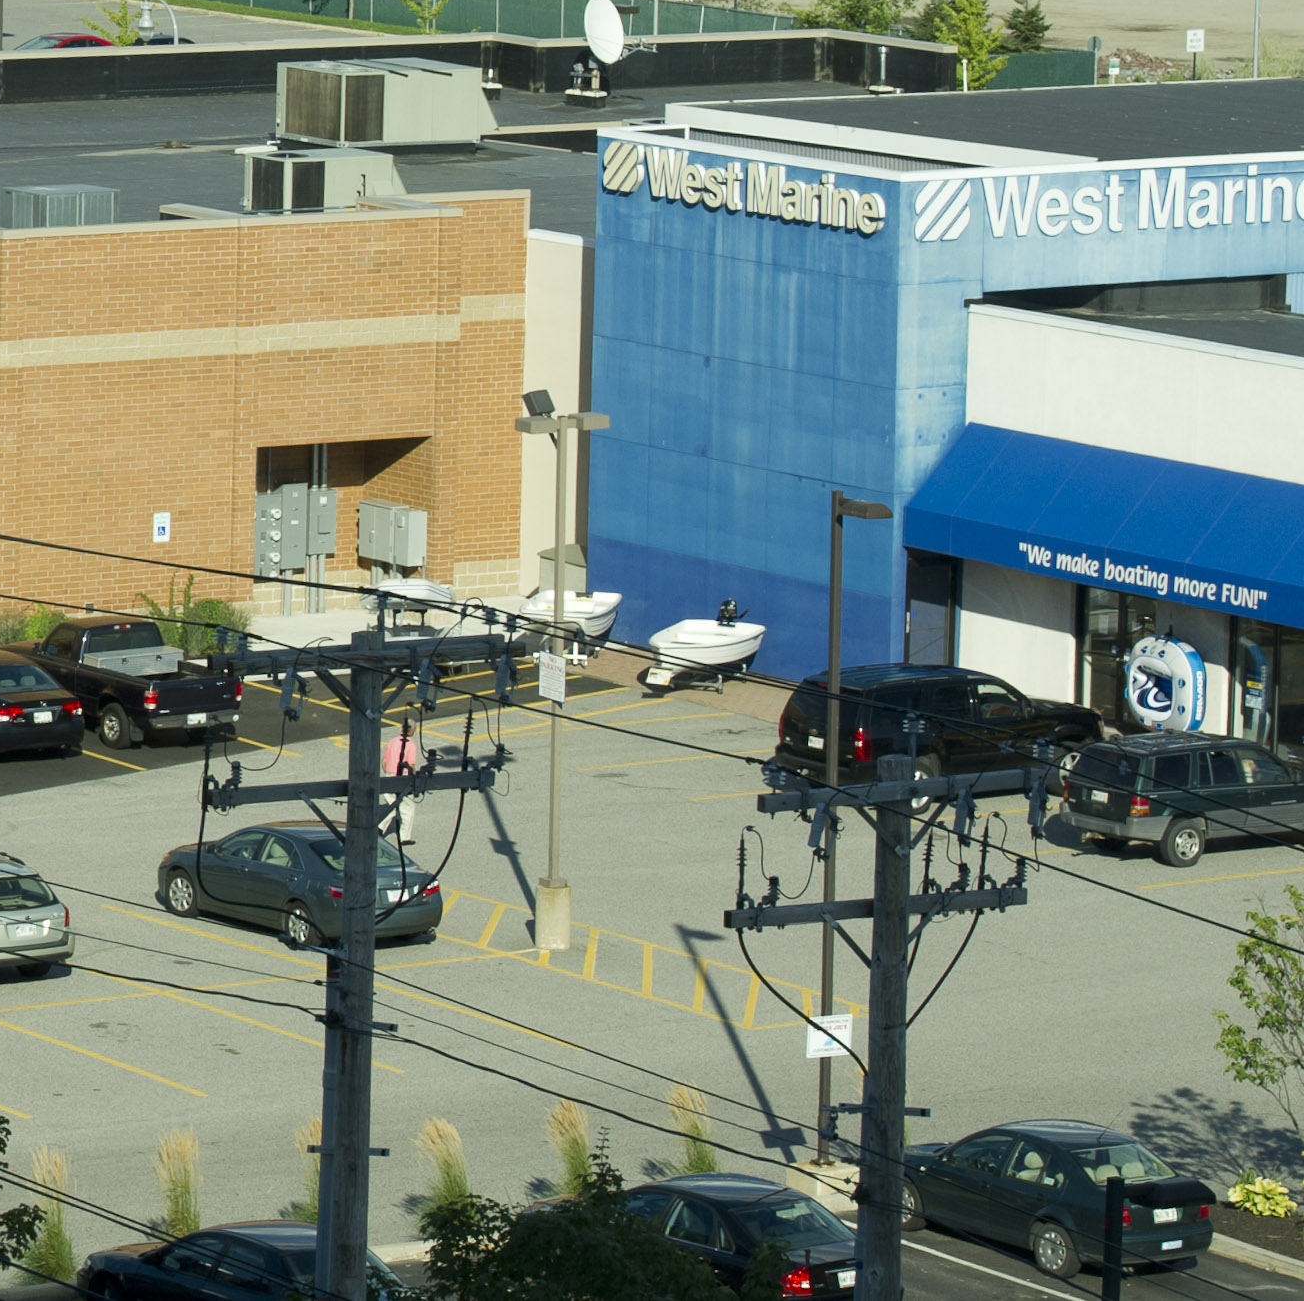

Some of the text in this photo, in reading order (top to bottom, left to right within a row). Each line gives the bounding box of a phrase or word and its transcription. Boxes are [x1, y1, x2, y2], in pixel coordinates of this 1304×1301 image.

[645, 145, 886, 236] West Marine
[982, 164, 1304, 238] West Marin
[1019, 542, 1267, 609] "We make boating more FUN!"
